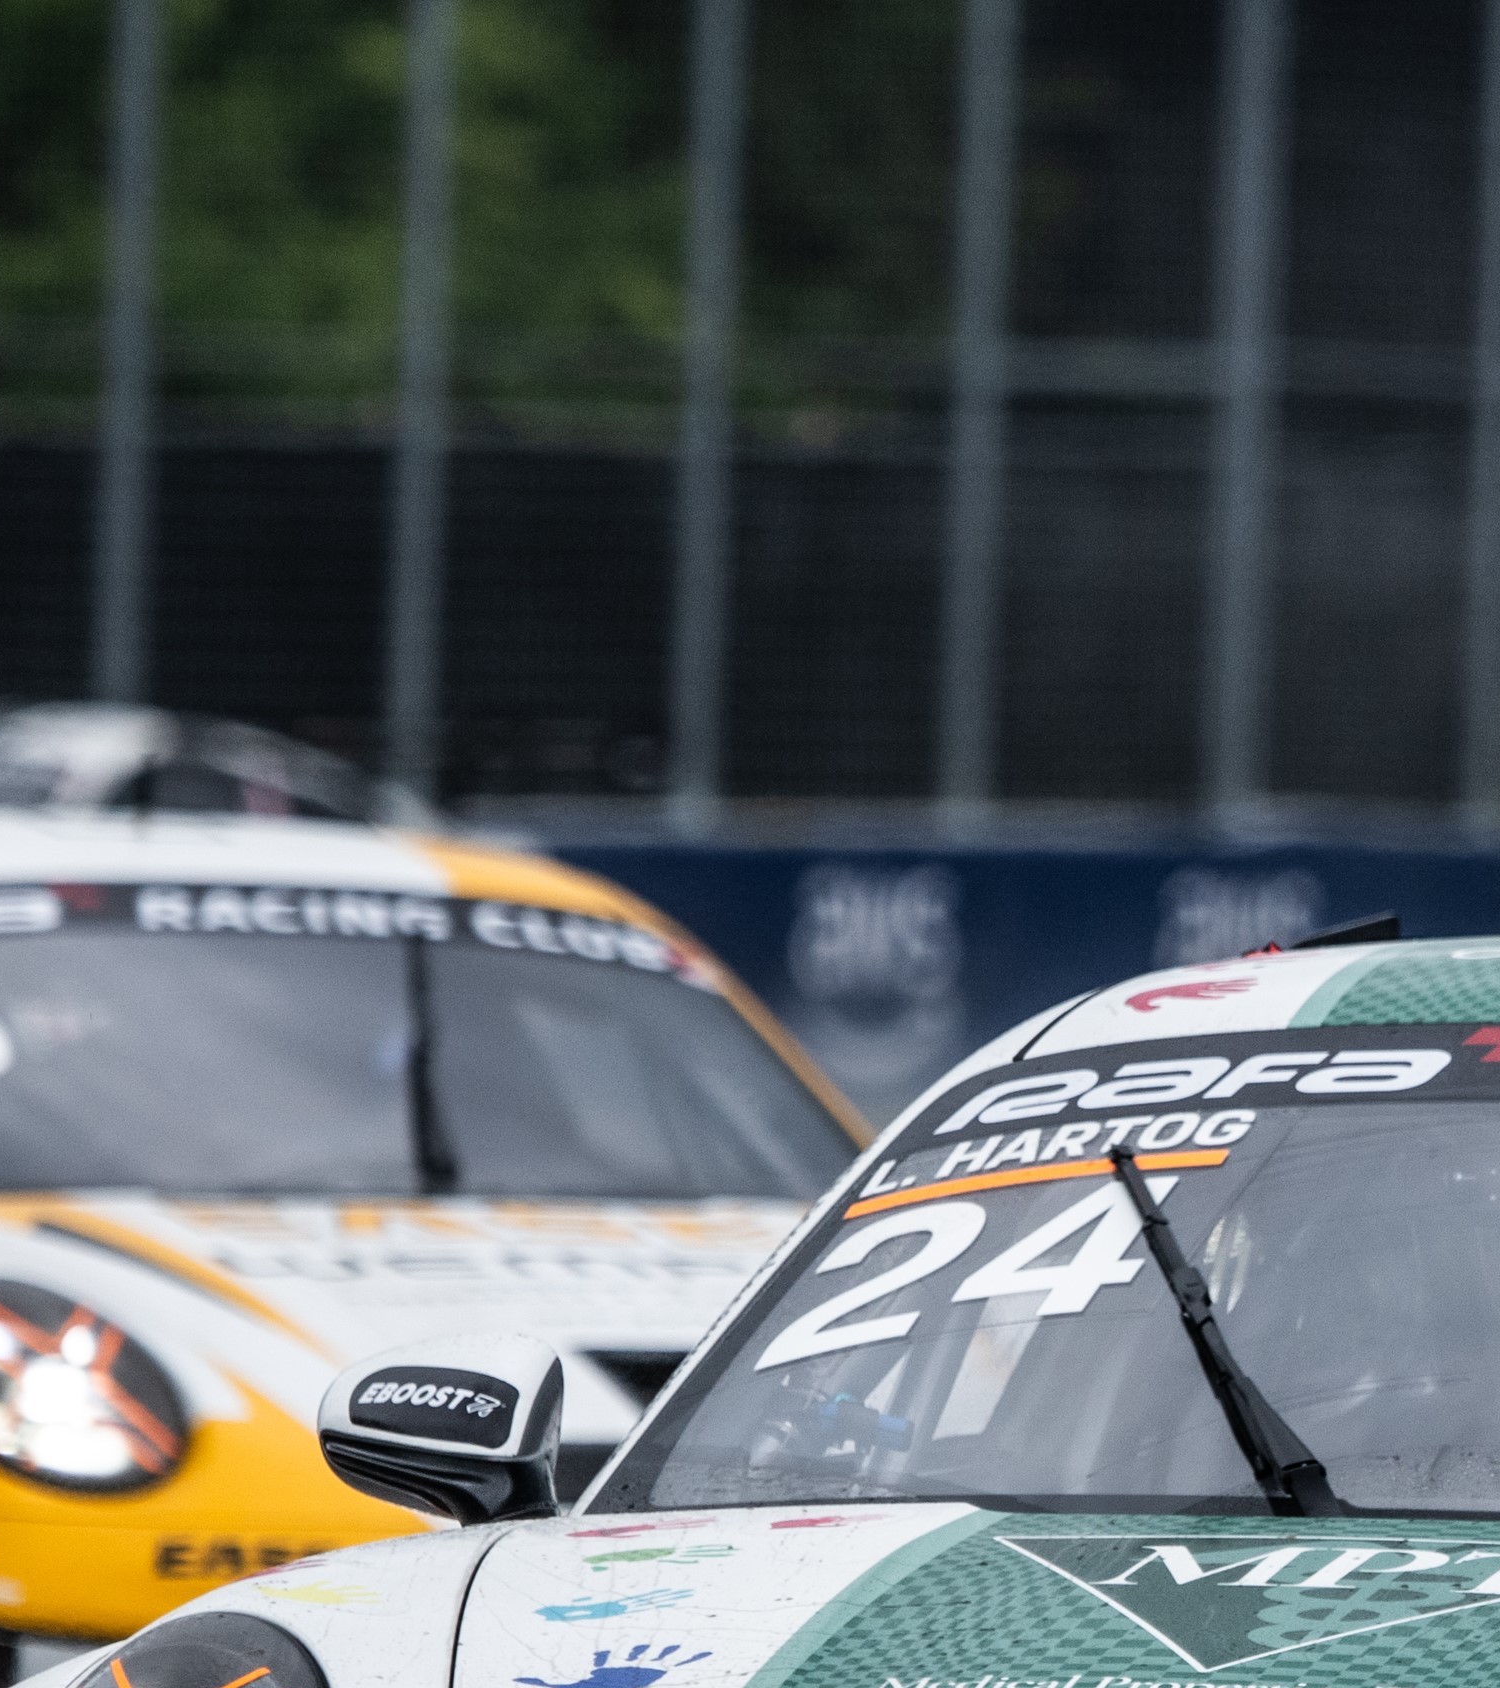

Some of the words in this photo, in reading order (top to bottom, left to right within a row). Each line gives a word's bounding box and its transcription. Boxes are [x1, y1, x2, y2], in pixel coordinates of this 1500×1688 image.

[135, 886, 452, 940] RACING
[858, 1156, 917, 1200] L.
[935, 1108, 1257, 1179] HARTOG
[754, 1175, 1180, 1372] 24
